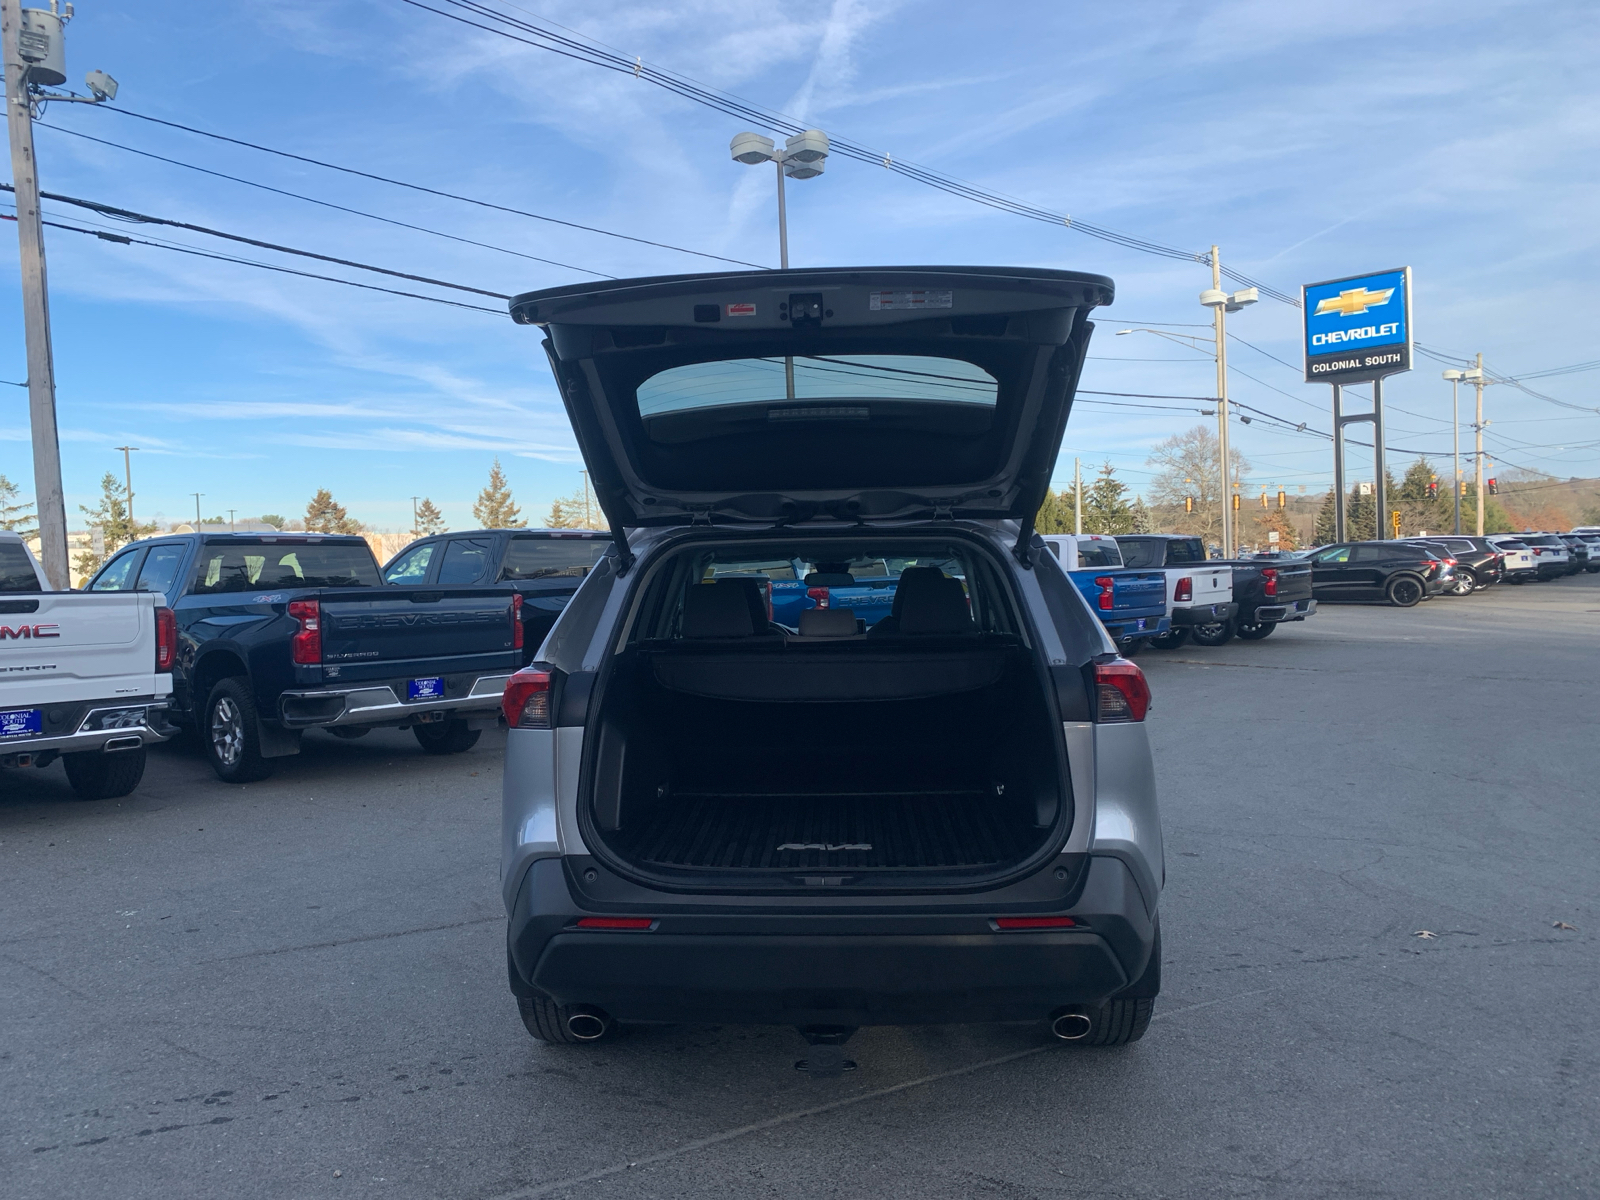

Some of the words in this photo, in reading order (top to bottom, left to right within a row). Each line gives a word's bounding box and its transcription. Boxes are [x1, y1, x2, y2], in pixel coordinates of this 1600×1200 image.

[1312, 322, 1400, 346] CHEVROLET
[1312, 359, 1362, 373] COLONIAL
[1365, 353, 1401, 366] SOUTH
[839, 595, 896, 607] CHEVRO
[0, 624, 60, 640] MC
